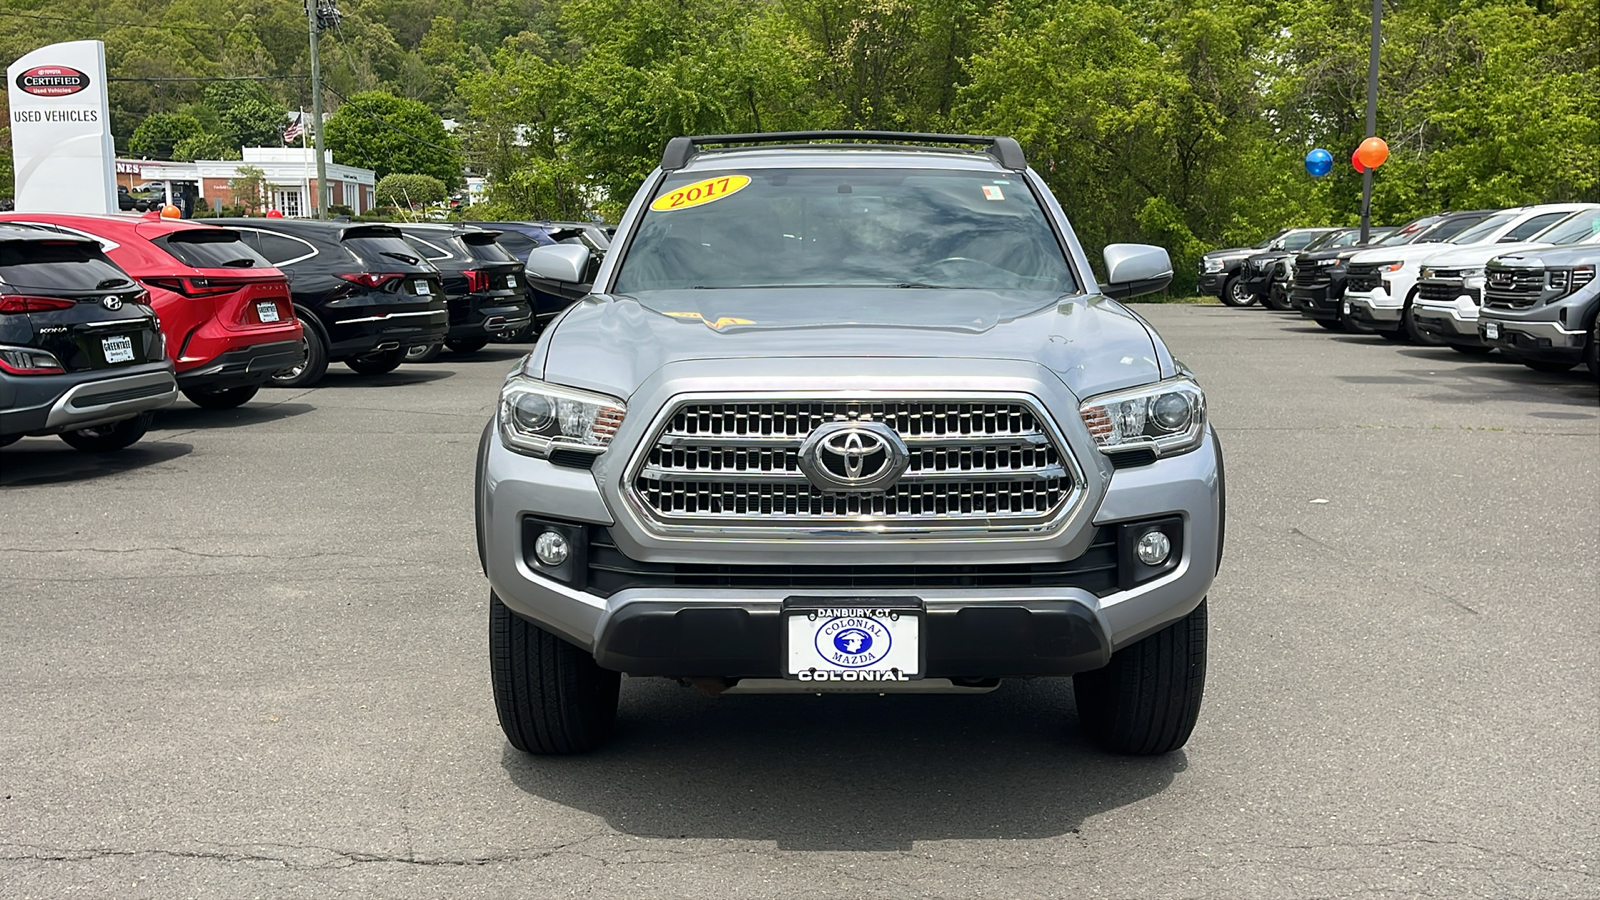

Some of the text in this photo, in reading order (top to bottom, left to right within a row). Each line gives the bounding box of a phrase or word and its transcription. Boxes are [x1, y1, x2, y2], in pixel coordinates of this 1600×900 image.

[14, 110, 98, 123] USED VEHICLES
[670, 178, 730, 208] 2017
[104, 341, 131, 351] GREENTREE
[818, 609, 891, 618] DANBURY, CT
[825, 619, 882, 638] COLONIAL
[832, 652, 876, 665] MAZDA
[798, 670, 910, 682] COLONIAL
